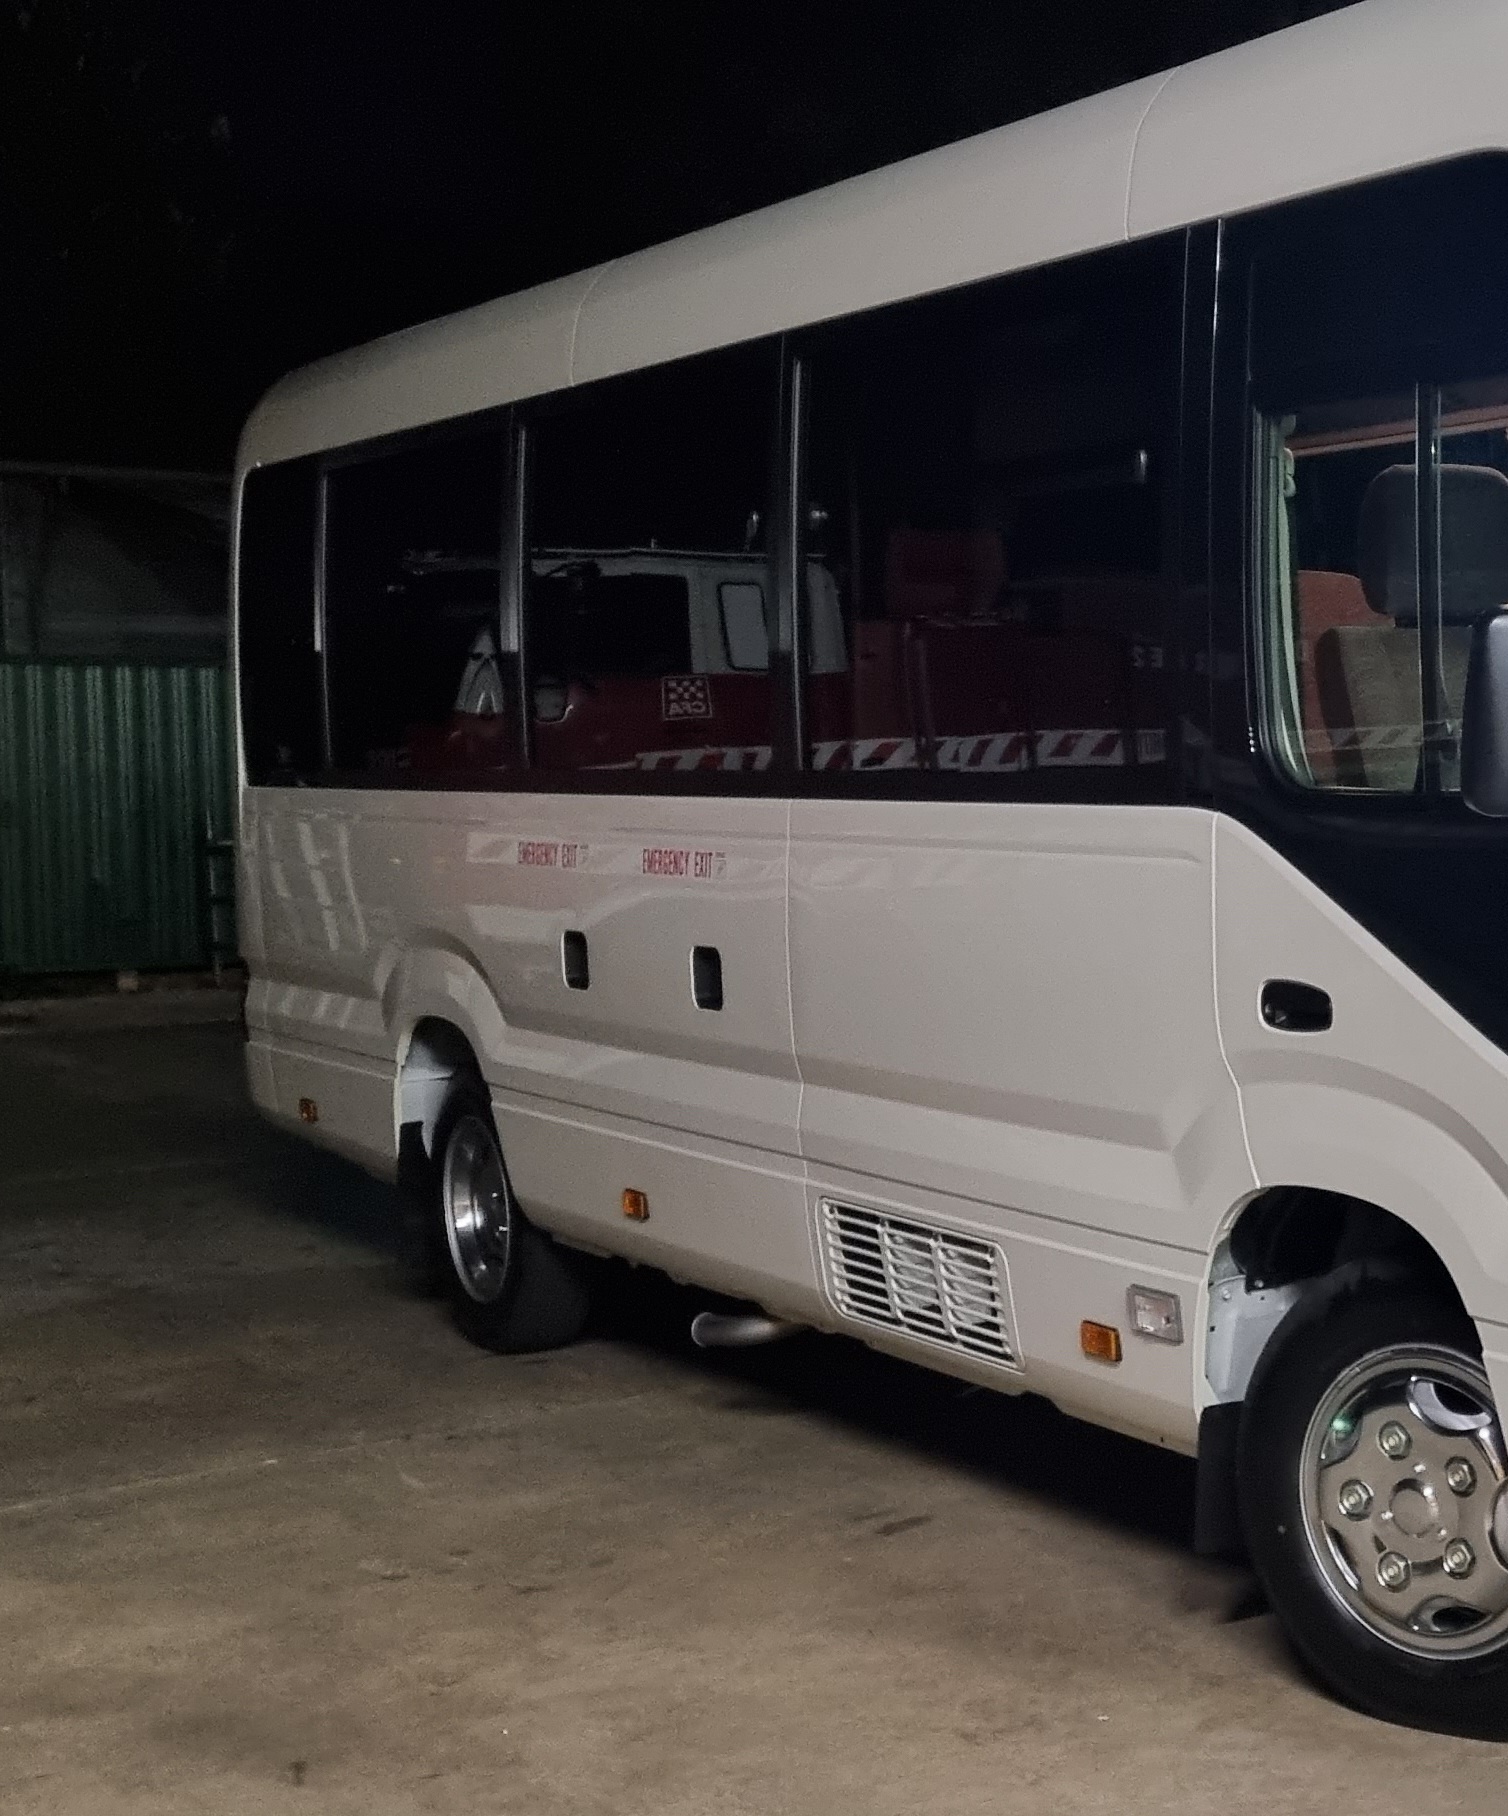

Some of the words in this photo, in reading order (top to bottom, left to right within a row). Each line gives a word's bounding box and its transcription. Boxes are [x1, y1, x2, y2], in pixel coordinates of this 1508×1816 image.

[518, 841, 558, 866] EMERGENCY
[561, 843, 577, 868] EXIT
[642, 849, 690, 876] EMERGENCY
[694, 851, 712, 878] EXIT
